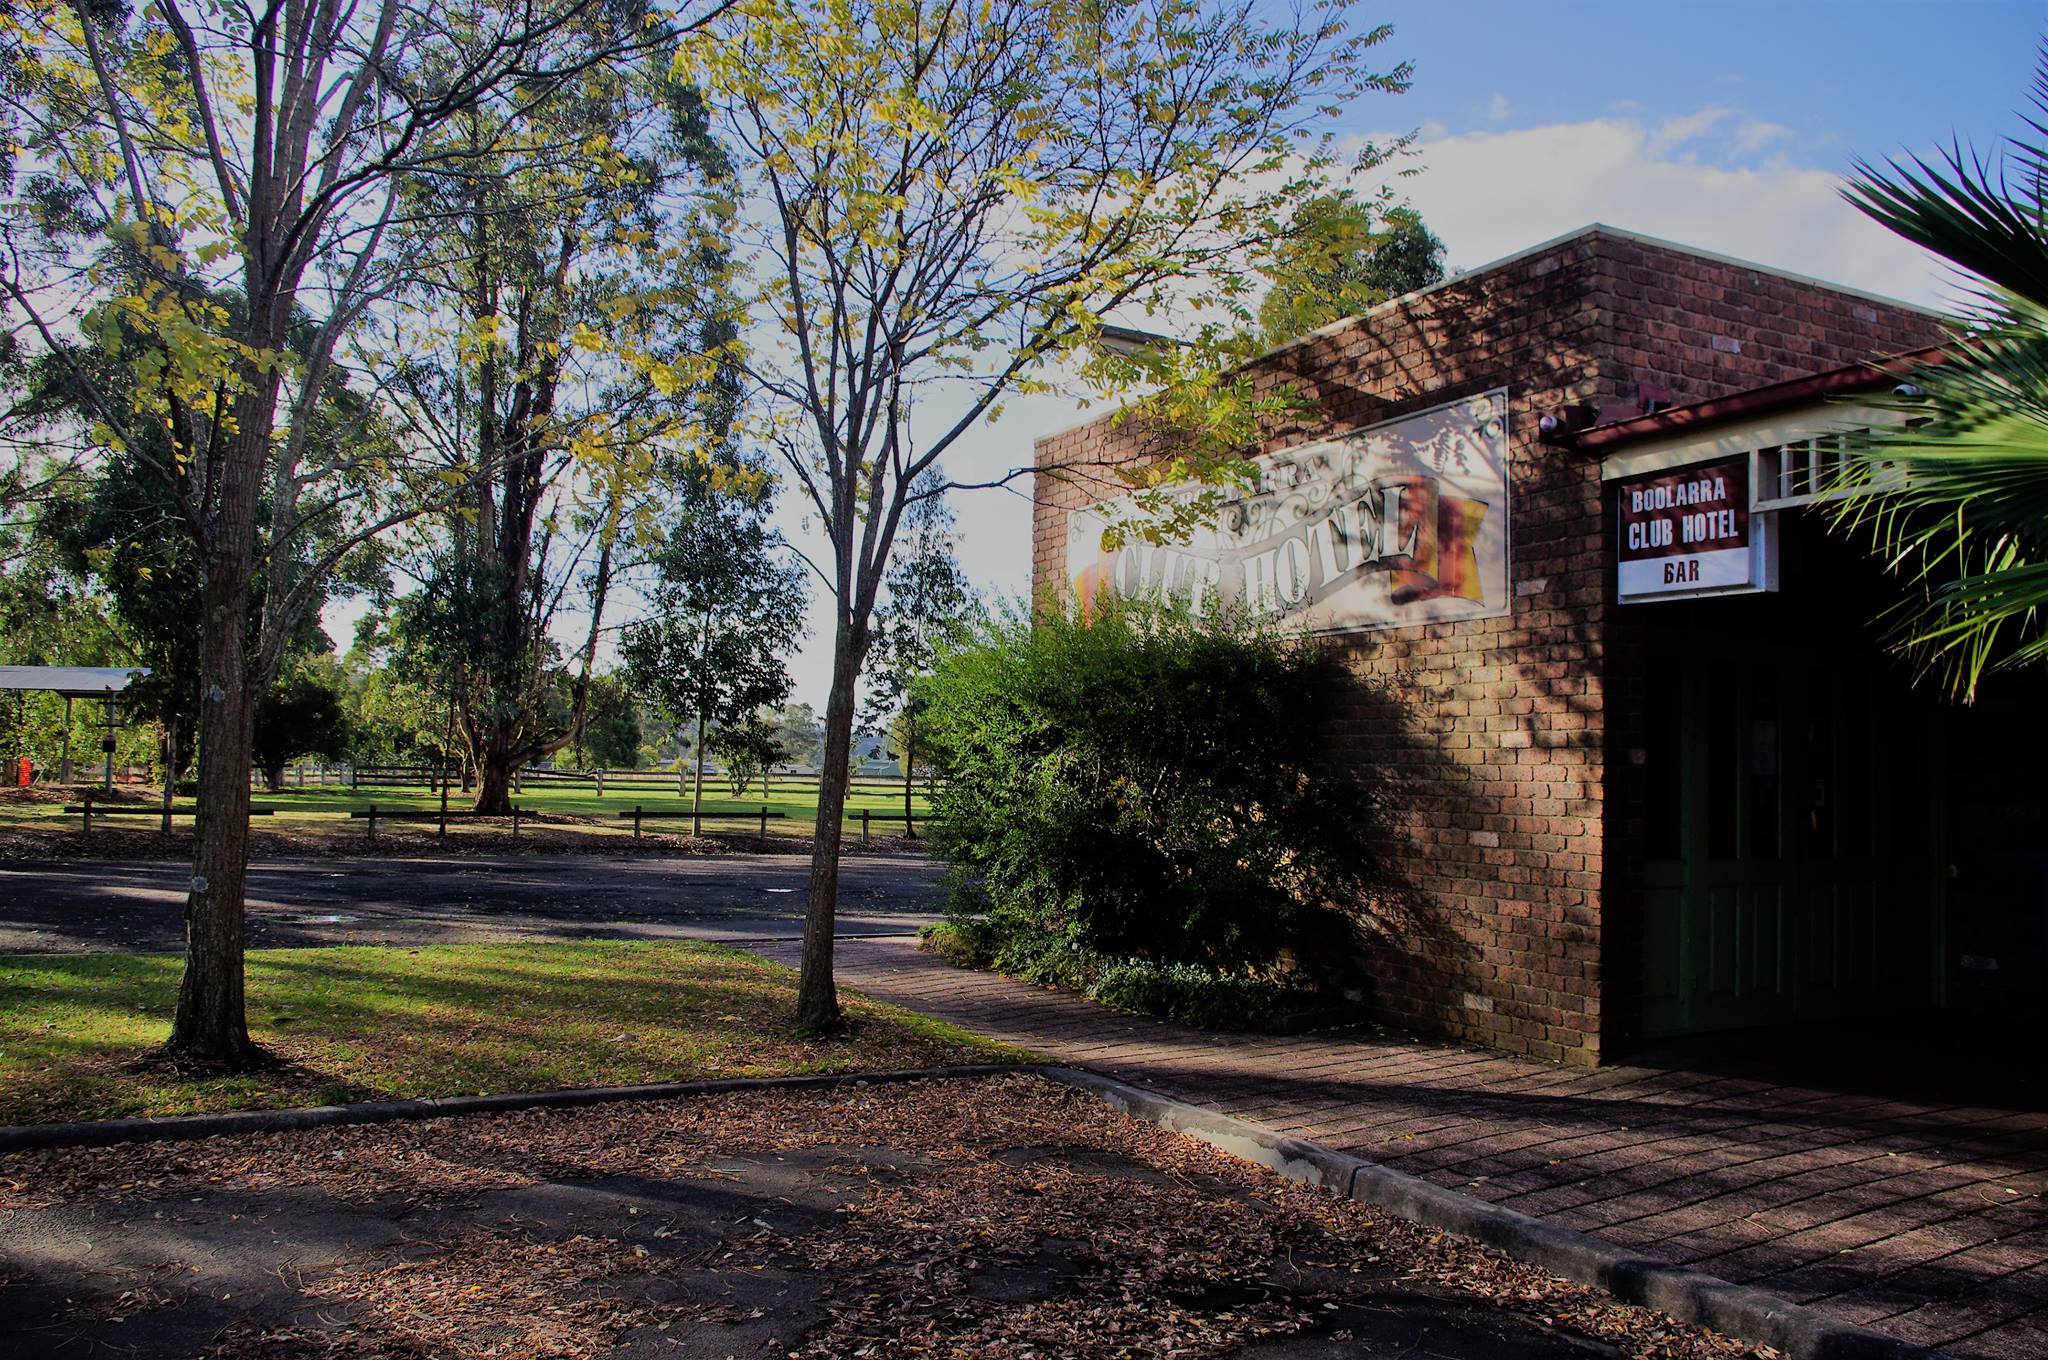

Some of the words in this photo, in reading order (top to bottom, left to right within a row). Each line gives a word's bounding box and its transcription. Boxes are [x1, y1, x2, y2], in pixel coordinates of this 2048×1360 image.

[1632, 477, 1726, 513] BOOLARRA
[1628, 518, 1673, 550] CLUB
[1682, 509, 1739, 544] HOTEL
[1240, 485, 1418, 617] HOTEL
[1664, 559, 1700, 584] BAR
